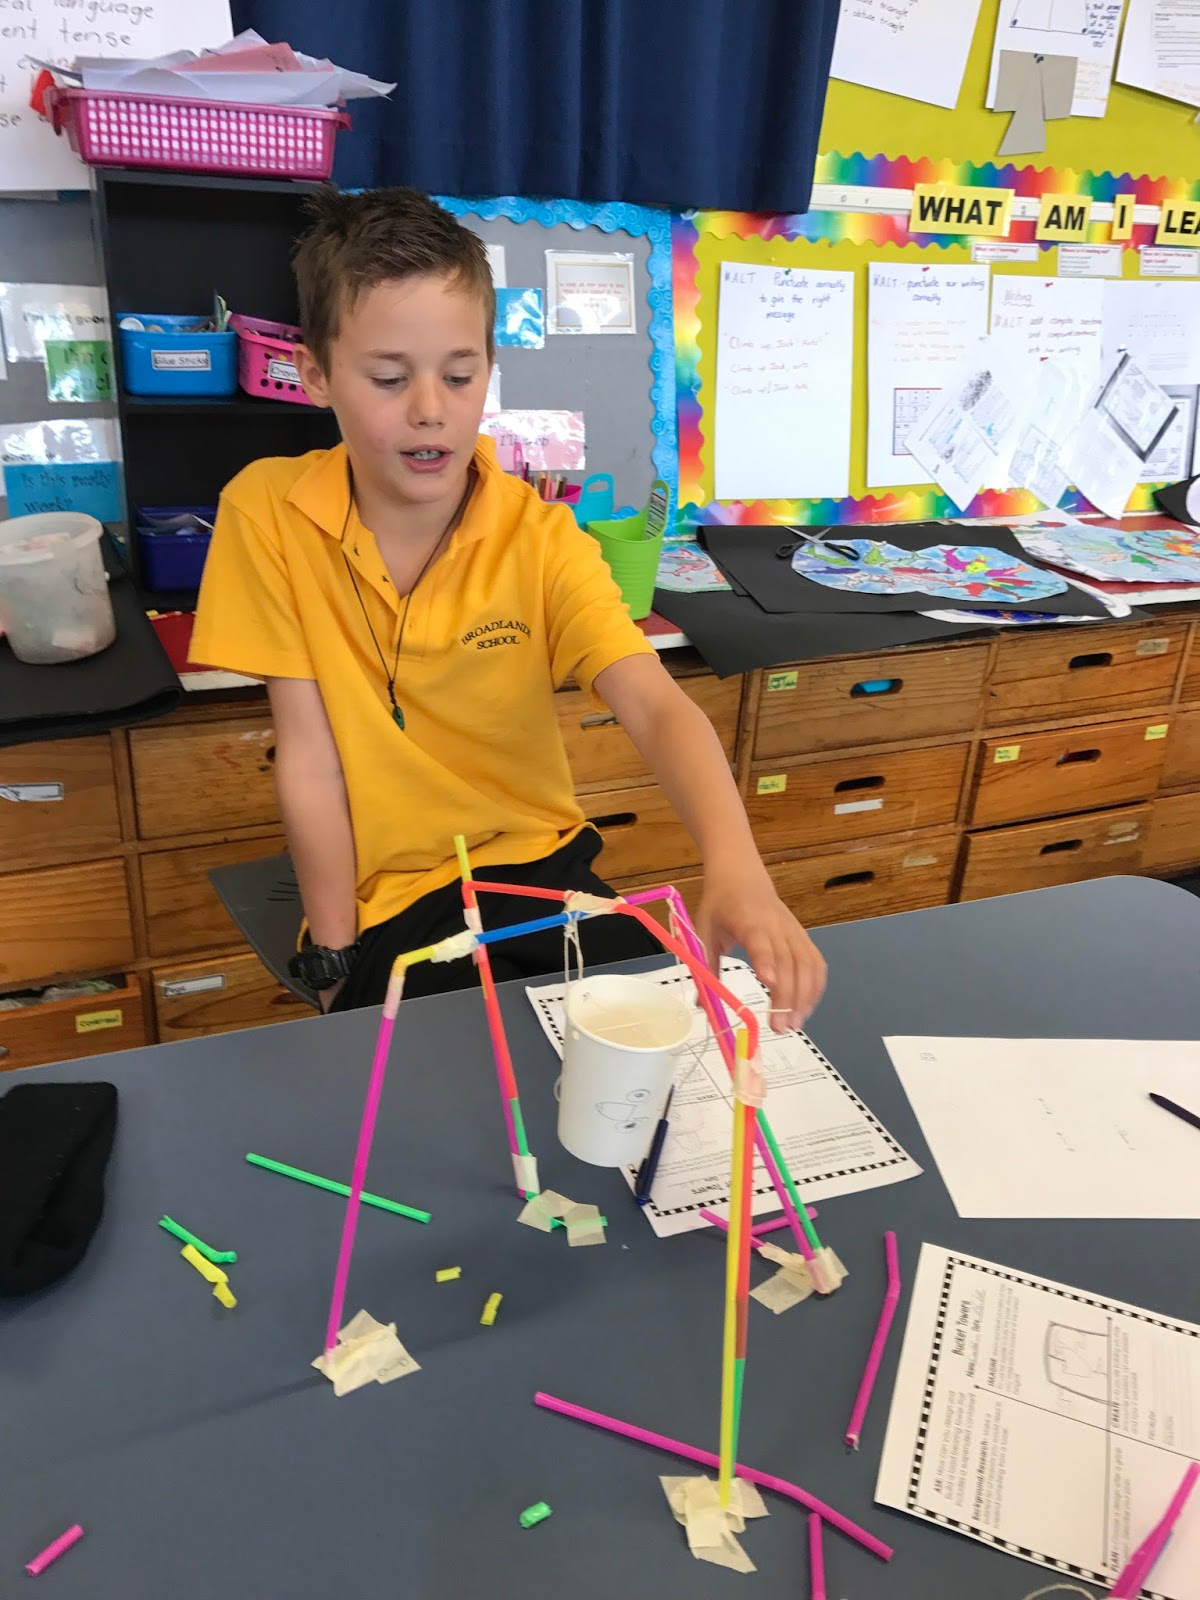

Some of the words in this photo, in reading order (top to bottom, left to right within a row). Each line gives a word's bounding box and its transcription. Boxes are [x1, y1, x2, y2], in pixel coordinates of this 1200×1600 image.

[54, 0, 154, 25] language
[59, 17, 131, 48] tense
[919, 196, 1003, 226] WHAT
[1044, 205, 1087, 230] AM
[1117, 205, 1126, 229] I
[961, 277, 985, 291] writing
[812, 294, 831, 308] right
[179, 356, 209, 366] Sticks
[271, 366, 299, 379] Crayo
[477, 635, 520, 650] SCHOOL
[690, 1184, 724, 1195] Towers
[956, 1298, 970, 1327] Towers
[952, 1327, 966, 1356] Bucket
